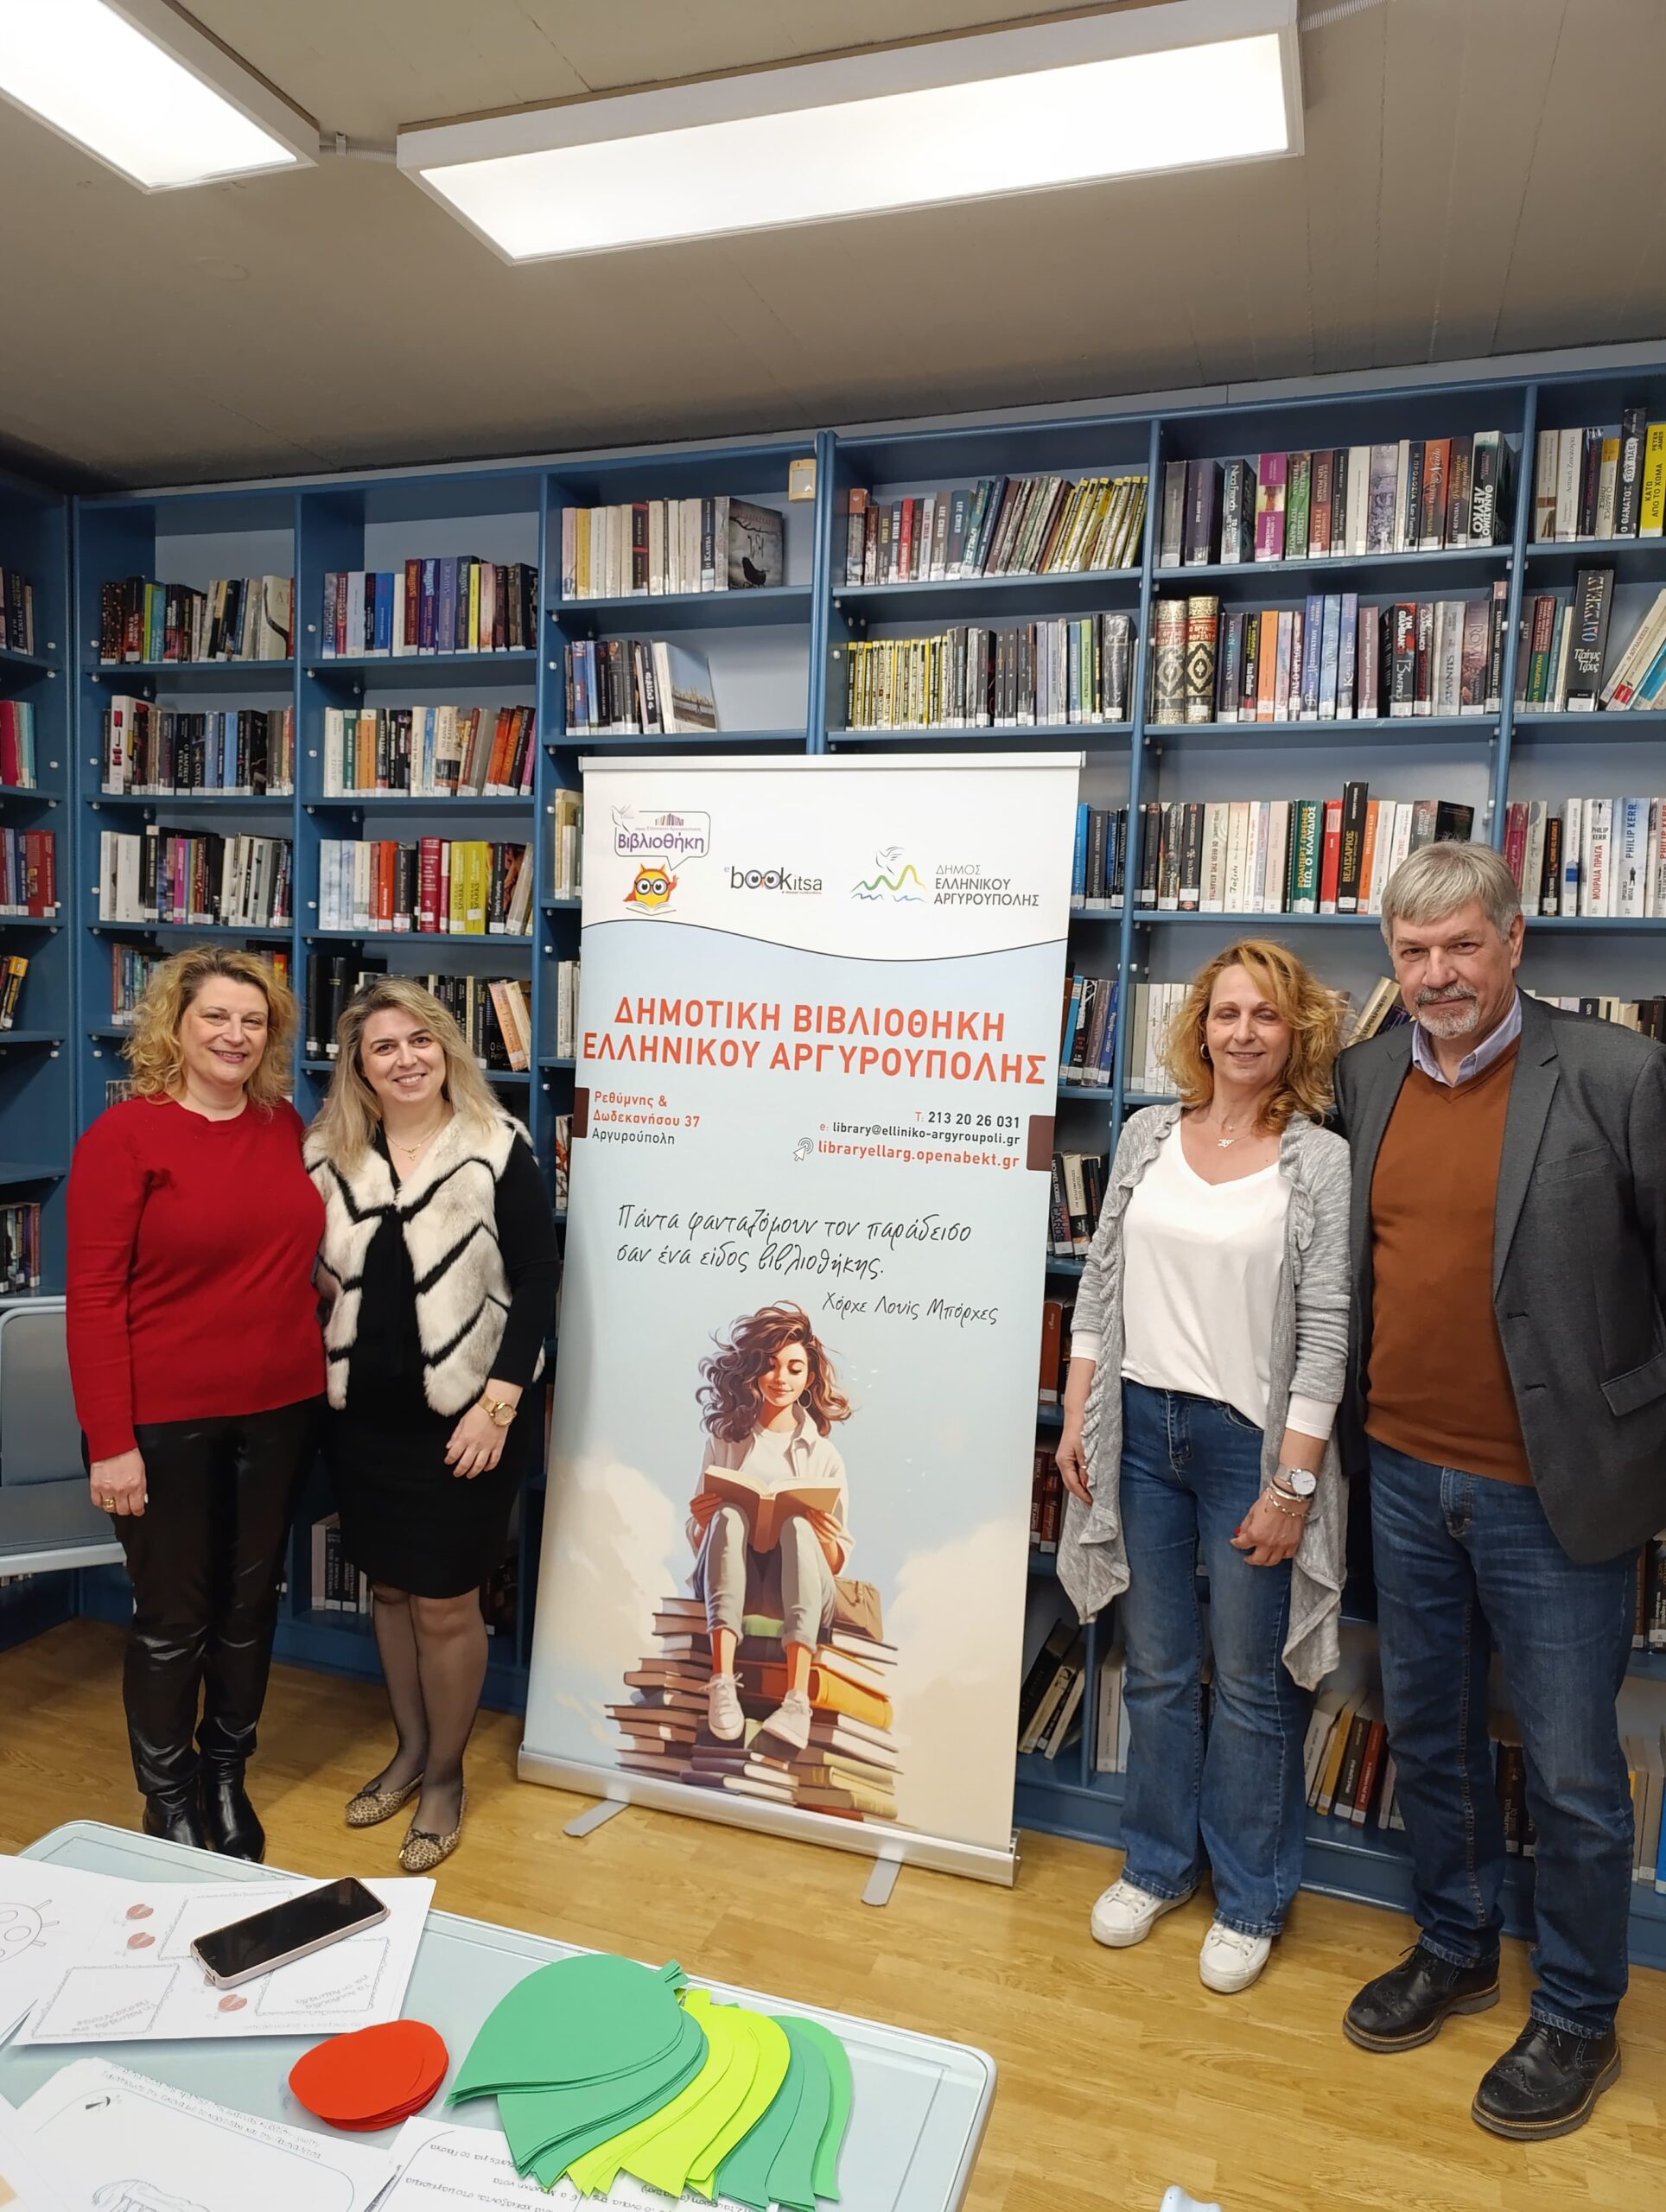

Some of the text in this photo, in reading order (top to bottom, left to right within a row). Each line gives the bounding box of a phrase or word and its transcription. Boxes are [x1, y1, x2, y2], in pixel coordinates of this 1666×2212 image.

[1625, 463, 1633, 480] ΣΟΥ
[1654, 463, 1663, 486] ΧΩΜΑ
[1621, 485, 1631, 524] ΘΑΝΑΤΟΣ
[1653, 488, 1661, 499] ΤΟ
[938, 506, 946, 517] LEE
[1472, 486, 1485, 534] ΛΕΥΚΟ
[1481, 485, 1494, 537] ΘΑΝΑΣΙΜΟ
[937, 518, 945, 538] CHILD
[954, 514, 963, 533] CHILD
[1580, 575, 1605, 642] ΟΔΥΣΣΕΑΣ
[1305, 805, 1316, 855] ΚΛΑΥΔΙΟΣ
[1625, 804, 1637, 859] PHILIP KERR
[618, 832, 705, 853] Βιβλιοθήκη
[1305, 857, 1313, 866] Ο
[1342, 830, 1354, 882] ΒΕΛΙΣΑΡΙΟΣ
[935, 864, 982, 875] ΔΗΜΟΣ
[1592, 844, 1603, 900] ΜΟΙΡΑΙΑ ΠΡΑΓΑ
[935, 878, 1011, 891] ΕΛΛΗΝΙΚΟΥ
[933, 893, 1040, 907] ΑΡΓΥΡΟΥΠΟΛΗΣ
[614, 996, 1006, 1043] ΔΗΜΟΤΙΚΗ ΒΙΒΛΙΟΘΗΚΗ
[582, 1032, 1046, 1085] ΕΛΛΗΝΙΚΟΥ ΑΡΓΥΡΟΥΠΟΛΗΣ
[595, 1090, 668, 1109] Ρεθύμνης &
[593, 1109, 700, 1128] Δωδεκανήσου 37
[927, 1111, 951, 1125] 213
[956, 1113, 971, 1126] 20
[976, 1114, 993, 1128] 26
[996, 1116, 1021, 1129] 031
[592, 1128, 675, 1145] Αργυρούπολη
[832, 1122, 1021, 1147] library@elliniko-argyroupoli.gr
[817, 1140, 1021, 1171] libraryellarg.openabekt.gr
[617, 1204, 972, 1251] Πάντα φανταζόμουν τον παράδεισο
[616, 1244, 652, 1263] σαν
[658, 1244, 691, 1266] ένα
[699, 1241, 751, 1274] είδος
[821, 1292, 1000, 1328] Χόρχε Λουίς Μπόρχες
